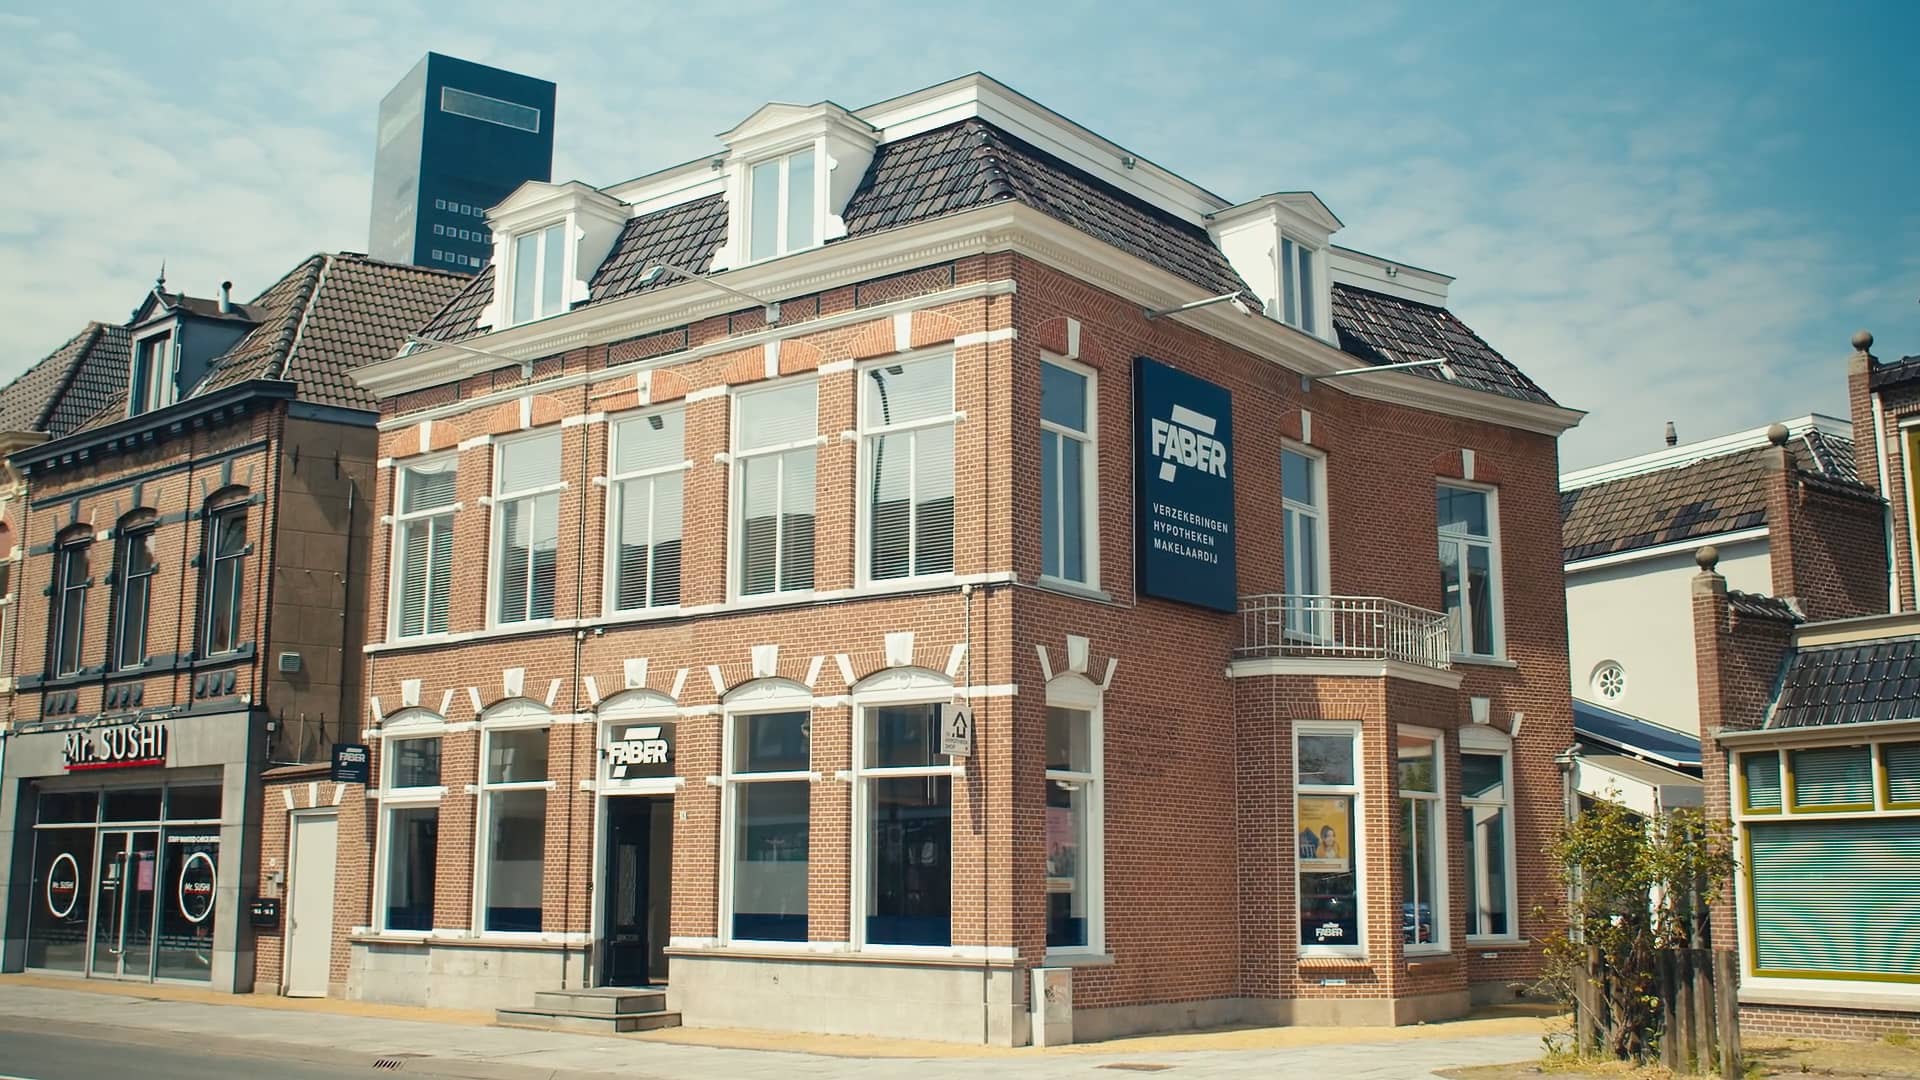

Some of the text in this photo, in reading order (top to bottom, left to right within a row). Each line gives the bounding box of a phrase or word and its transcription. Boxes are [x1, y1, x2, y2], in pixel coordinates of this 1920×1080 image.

[1151, 417, 1227, 479] FABER
[1153, 502, 1229, 534] VERZEKERINGEN
[1153, 520, 1215, 547] HYPOTHEKEN
[1153, 537, 1219, 565] MAKELAARDIJ
[63, 724, 165, 763] Mr. SUSHI
[339, 751, 366, 763] FABER
[609, 739, 669, 765] FABER
[1315, 927, 1343, 937] FABER
